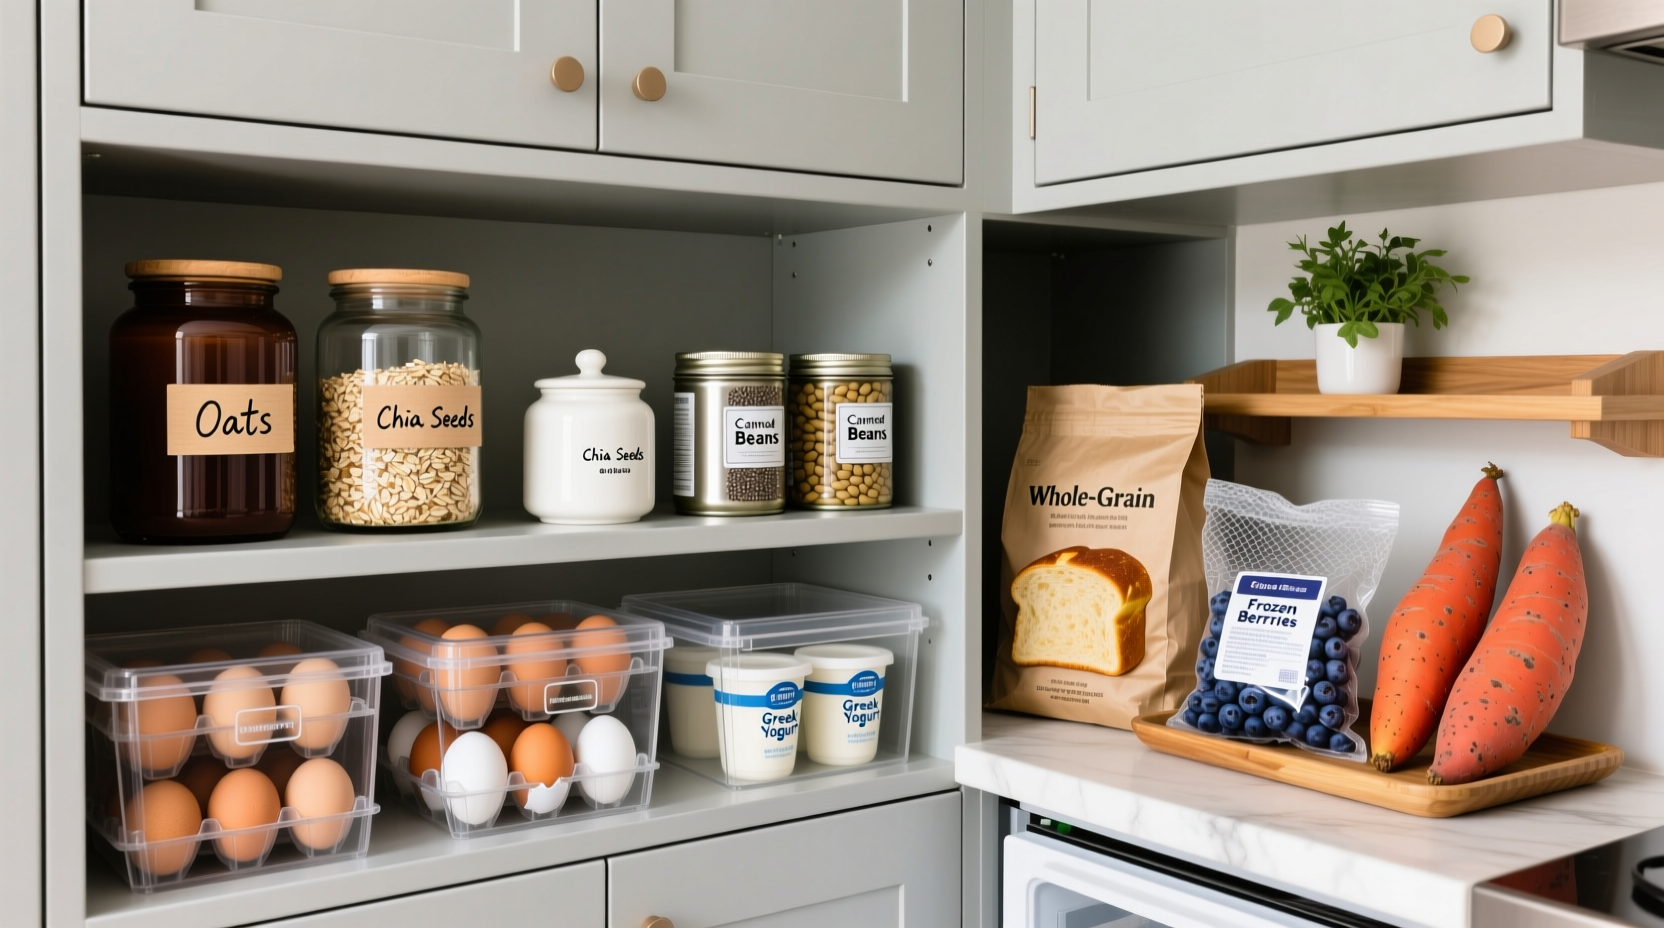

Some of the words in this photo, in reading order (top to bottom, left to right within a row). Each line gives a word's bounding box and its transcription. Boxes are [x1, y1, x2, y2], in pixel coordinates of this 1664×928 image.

[195, 398, 272, 438] Oats
[377, 404, 424, 429] Chia
[431, 404, 475, 429] Seeds
[735, 430, 779, 446] Beans
[848, 426, 888, 441] Beans
[582, 447, 611, 461] Chia
[1029, 484, 1156, 509] Whole-Grain
[1247, 598, 1297, 616] Frozen
